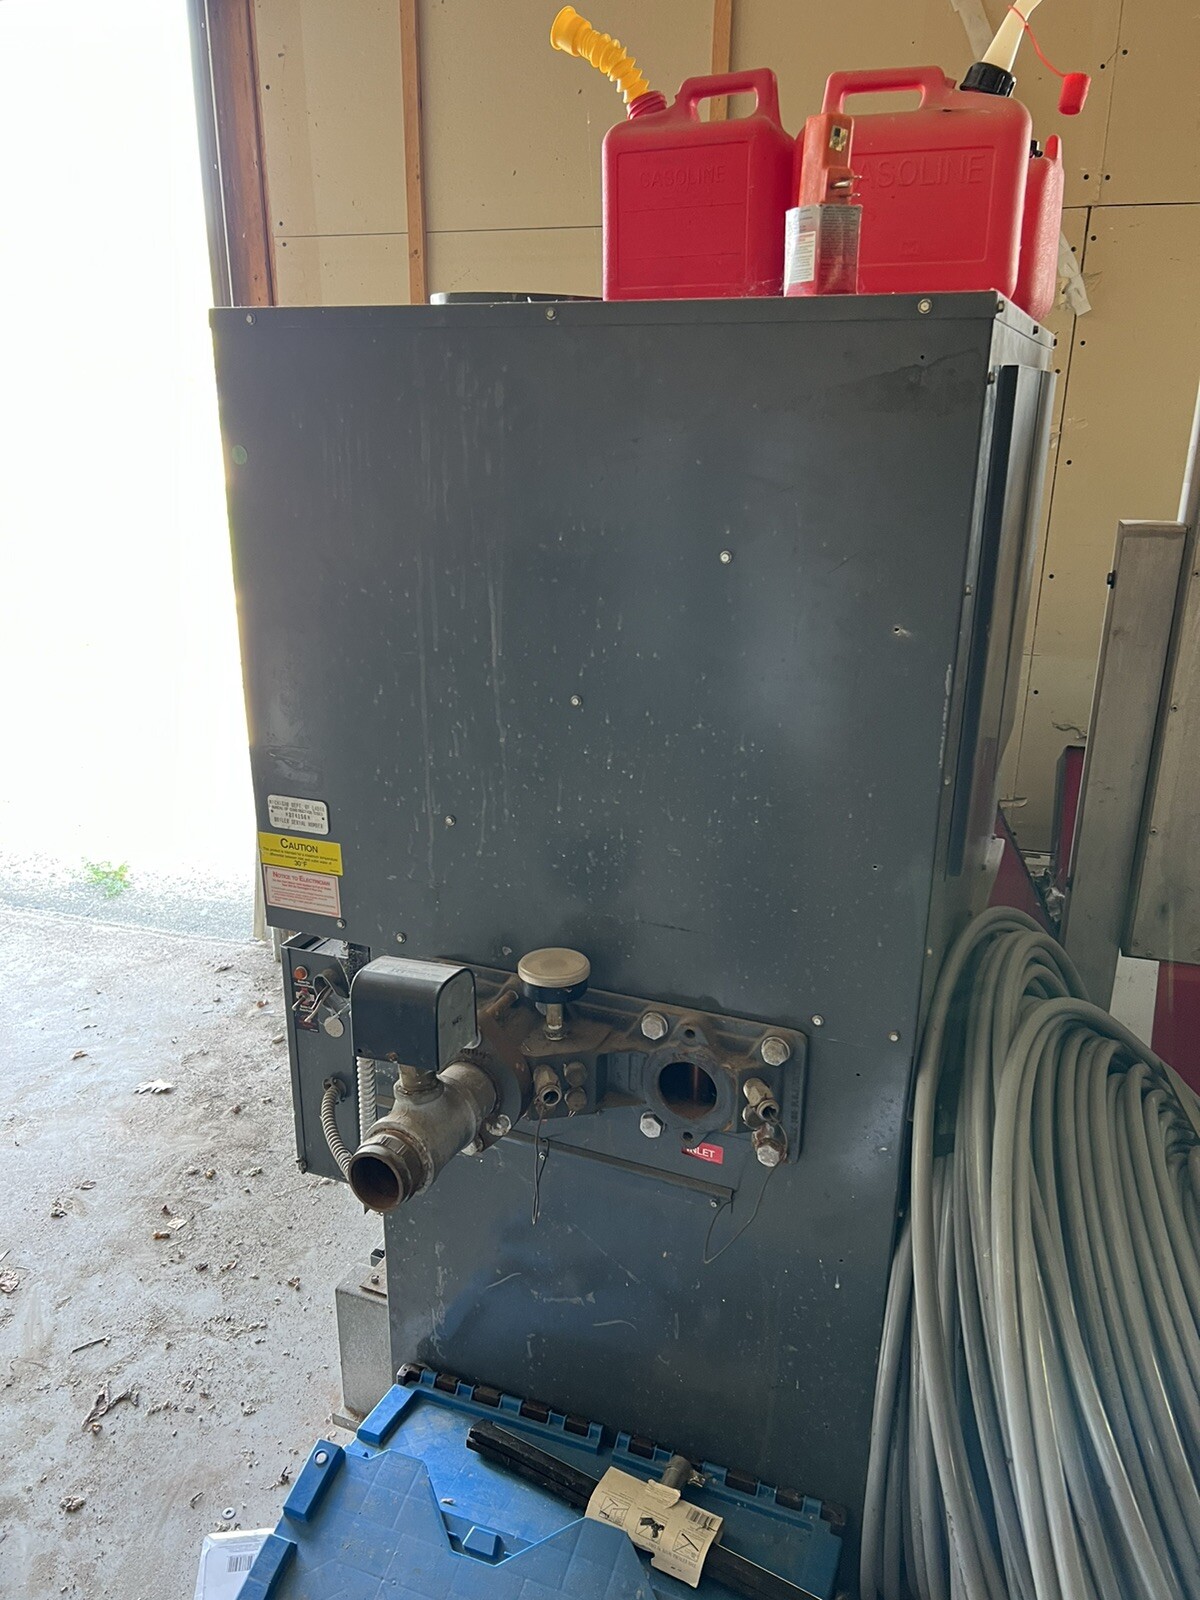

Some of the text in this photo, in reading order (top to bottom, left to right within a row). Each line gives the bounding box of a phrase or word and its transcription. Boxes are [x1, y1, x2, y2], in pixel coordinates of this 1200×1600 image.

[640, 165, 727, 188] GASOLINE
[853, 154, 985, 189] ASOLINE
[280, 838, 318, 853] CAUTION
